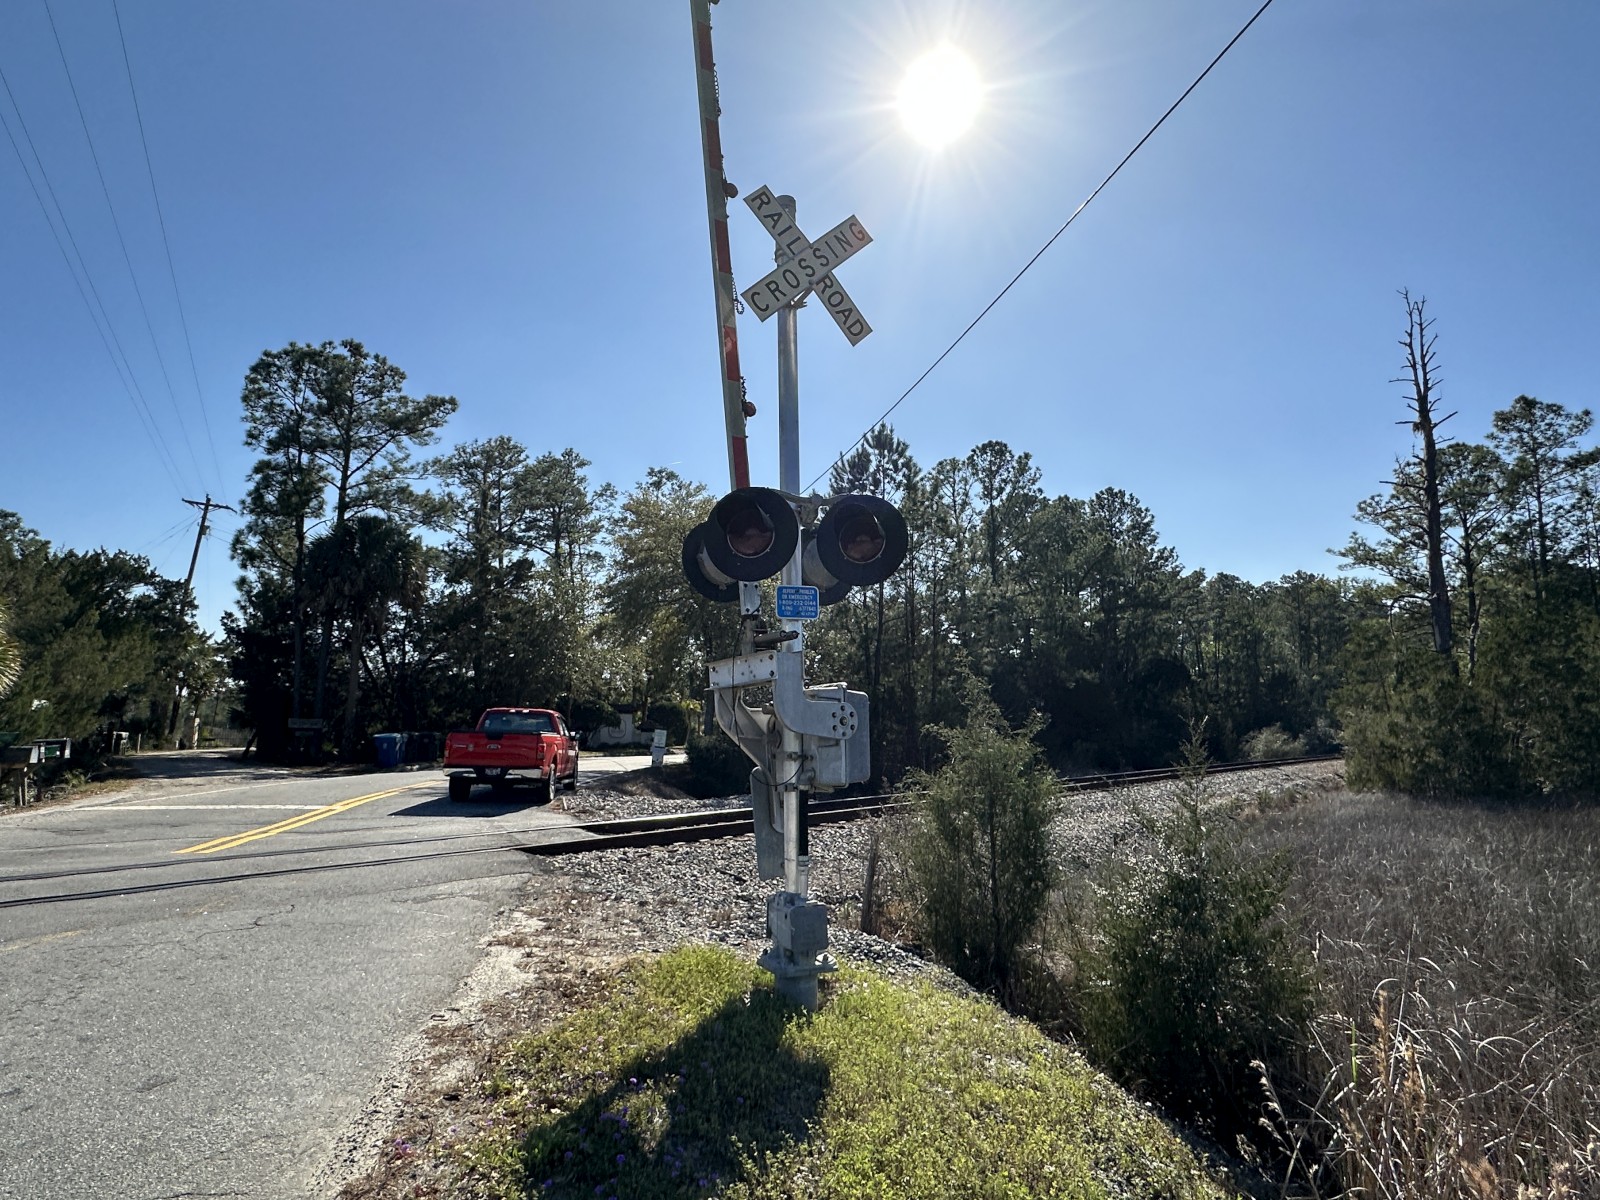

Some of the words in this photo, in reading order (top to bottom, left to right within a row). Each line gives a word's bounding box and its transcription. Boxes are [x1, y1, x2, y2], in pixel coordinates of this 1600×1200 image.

[750, 222, 866, 313] CROSSING
[751, 190, 801, 256] RAIL
[815, 274, 864, 337] ROAD
